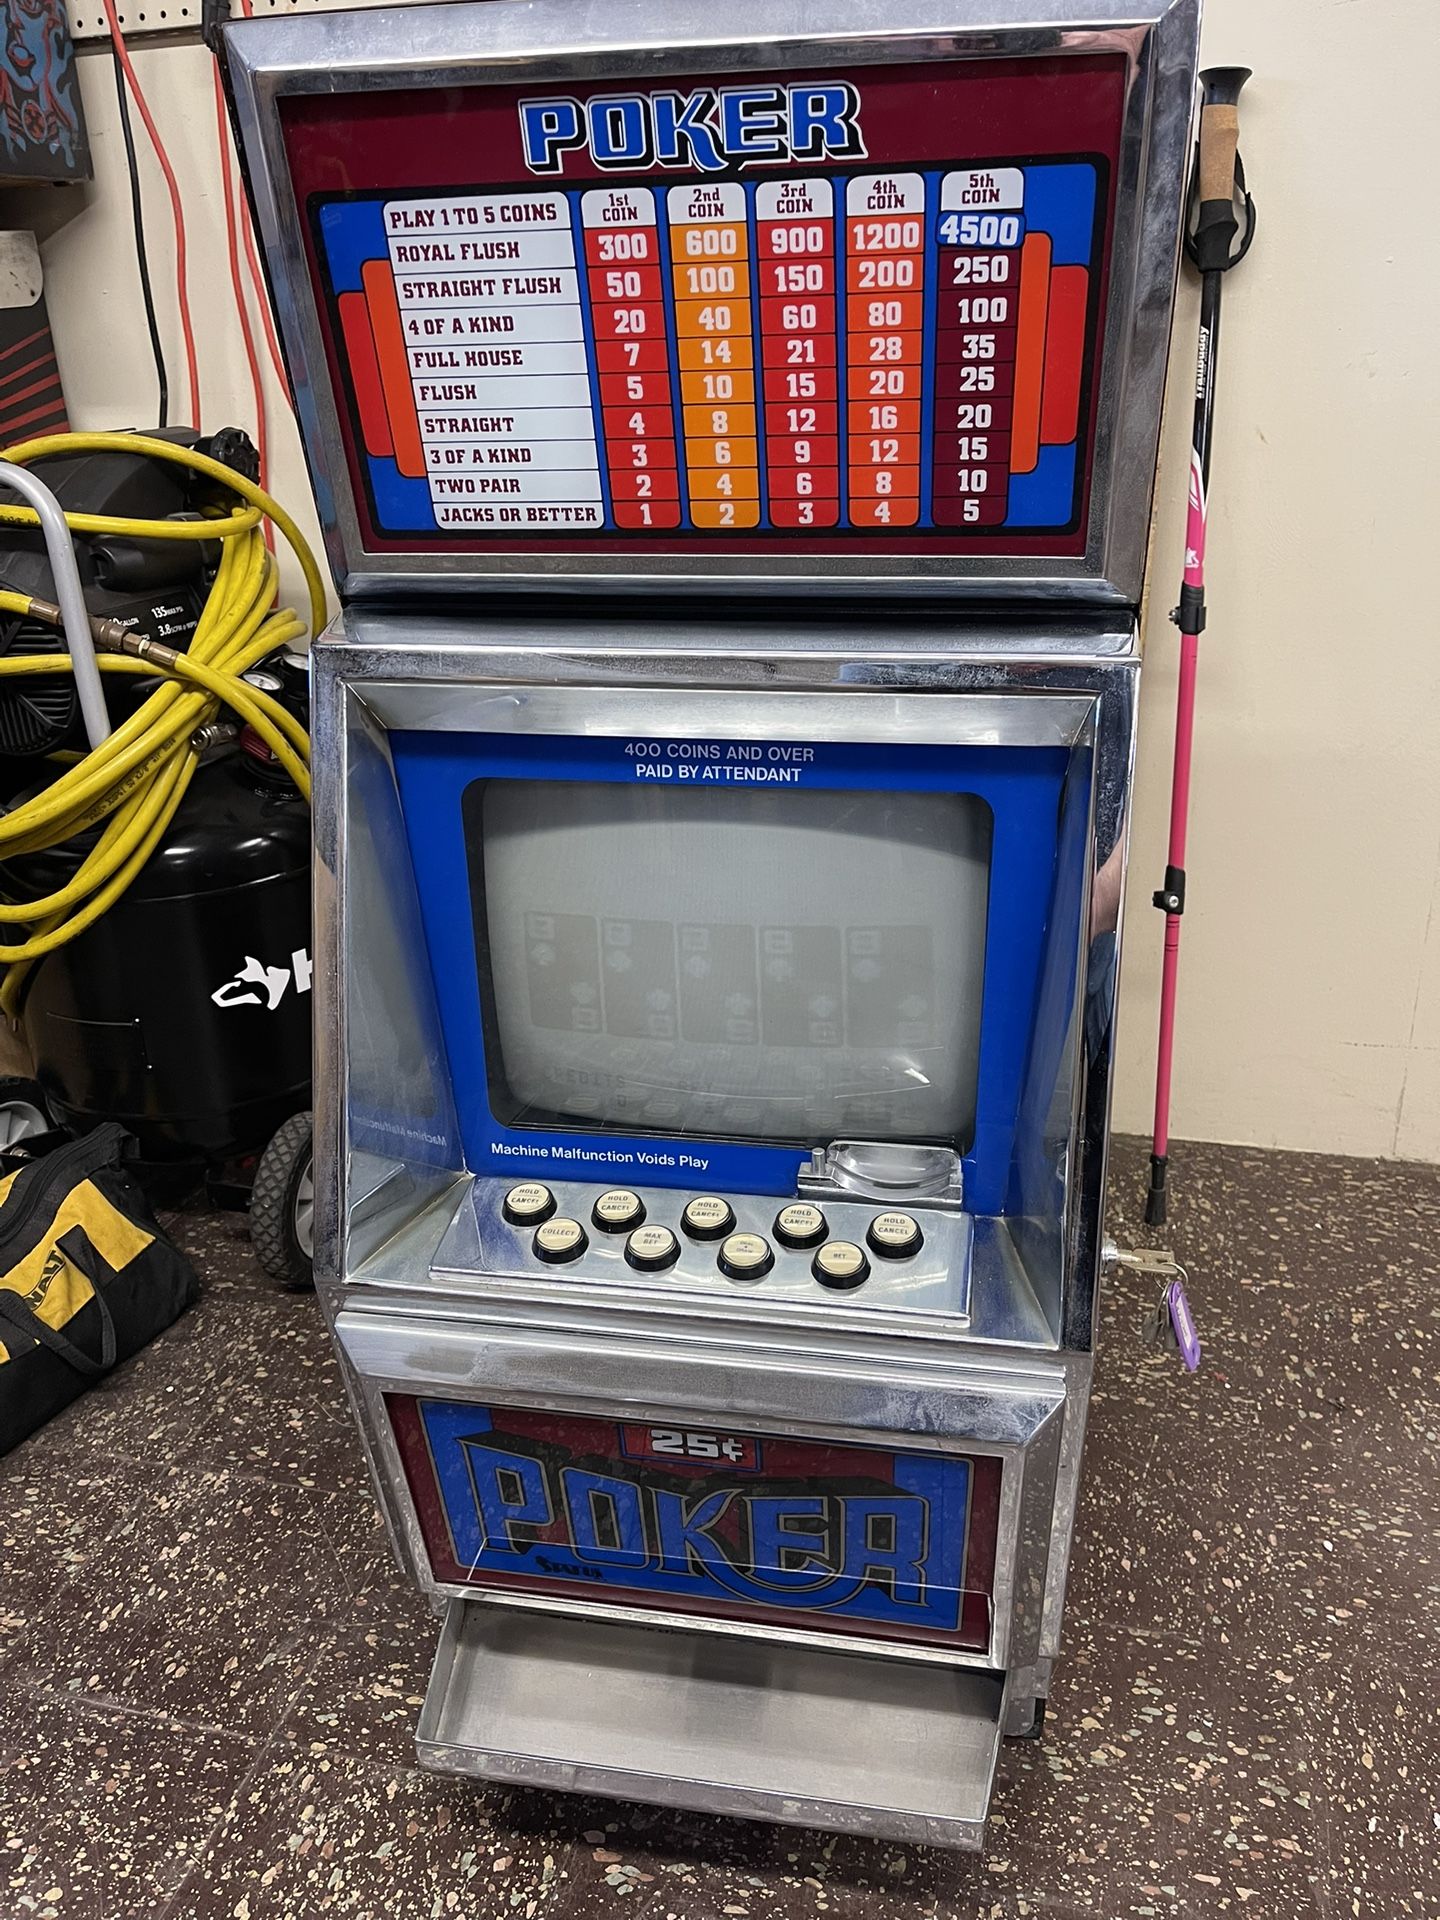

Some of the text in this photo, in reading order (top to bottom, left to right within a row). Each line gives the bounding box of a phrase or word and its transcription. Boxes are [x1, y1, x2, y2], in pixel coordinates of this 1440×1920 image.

[518, 80, 868, 174] POKER
[872, 180, 897, 195] 4th
[969, 173, 994, 188] 5th
[693, 187, 721, 202] 2nd
[780, 183, 807, 198] 3rd
[961, 188, 1000, 203] COIN
[608, 194, 629, 207] 1st
[688, 202, 724, 218] COIN
[776, 198, 813, 214] COIN
[867, 194, 905, 209] COIN
[391, 203, 557, 229] PLAY 1 TO 5 COINS
[602, 206, 638, 222] COIN
[397, 215, 1019, 263] ROYAL FLUSH 300 600 900 1200 4500
[402, 255, 1008, 299] STRAIGHT FLUSH 50 100 150 200 250
[408, 298, 1007, 336] 4 OF A KIND 20 40 60 80 100
[414, 334, 996, 369] FULL HOUSE 7 14 21 28 35
[419, 367, 995, 401] FLUSH 5 10 15 20 25
[424, 405, 992, 435] STRAIGHT 4 8 12 16 20
[431, 438, 988, 467] 3 OF A KIND 3 6 9 12 15
[435, 470, 987, 497] TWO PAIR 2 4 6 8 10
[441, 499, 980, 525] JACKS OR BETTER 1 2 3 4 5
[151, 606, 167, 618] 135
[158, 624, 172, 636] 3.8
[625, 743, 814, 762] 400 COINS AND OVER
[636, 764, 801, 781] PAID BY ATTENDANT
[491, 1143, 709, 1170] Machine Malfunction Voids Play
[542, 1228, 575, 1236] COLLECT
[650, 1429, 745, 1463] 25¢
[456, 1432, 929, 1607] POKER
